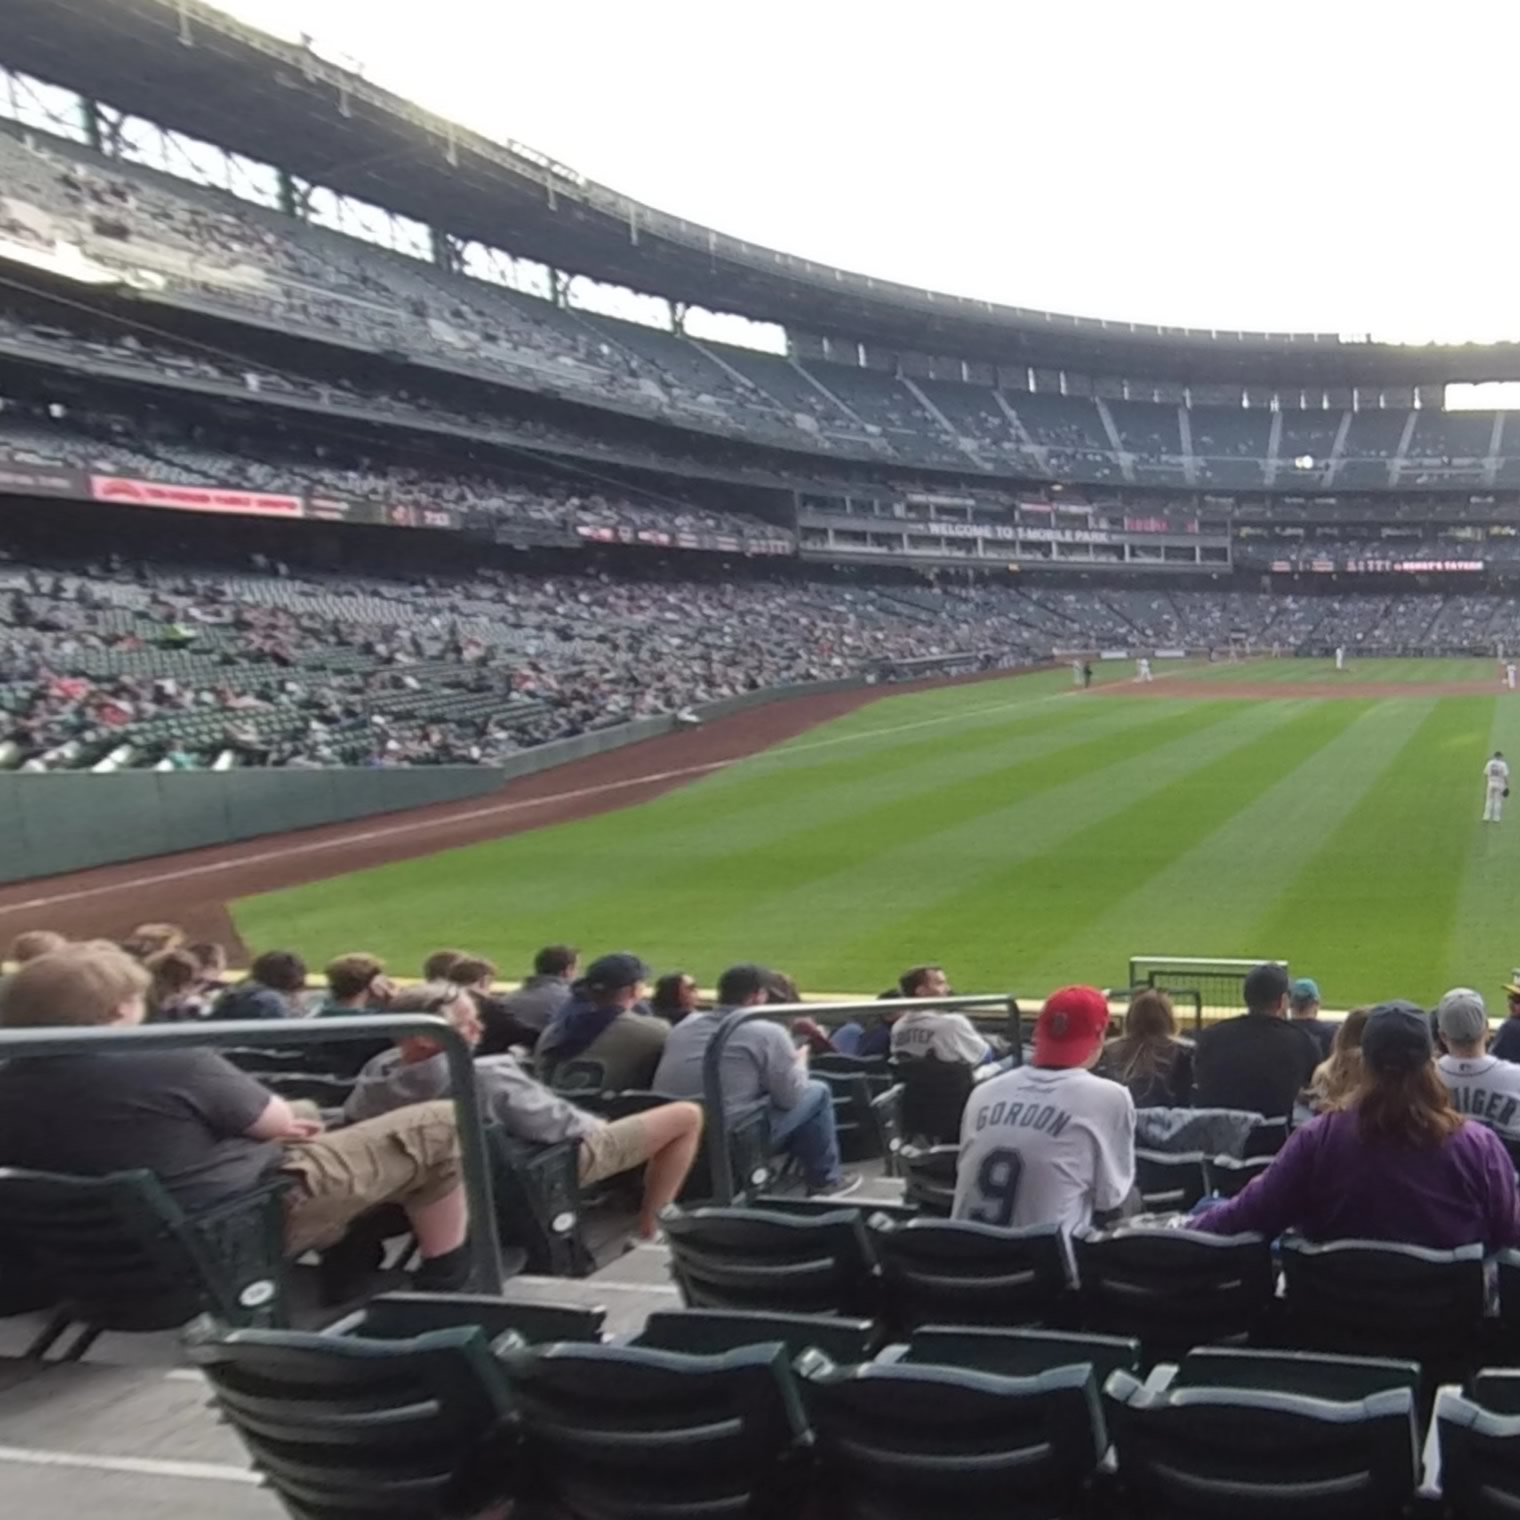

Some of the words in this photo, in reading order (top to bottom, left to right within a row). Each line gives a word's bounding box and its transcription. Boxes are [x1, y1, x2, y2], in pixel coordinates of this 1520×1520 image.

[928, 522, 992, 538] WELCOME
[996, 525, 1013, 539] TO
[1017, 527, 1073, 542] T-MOBILE
[1075, 530, 1108, 544] PARK
[976, 1101, 1072, 1138] GORDON
[968, 1145, 1027, 1227] 9
